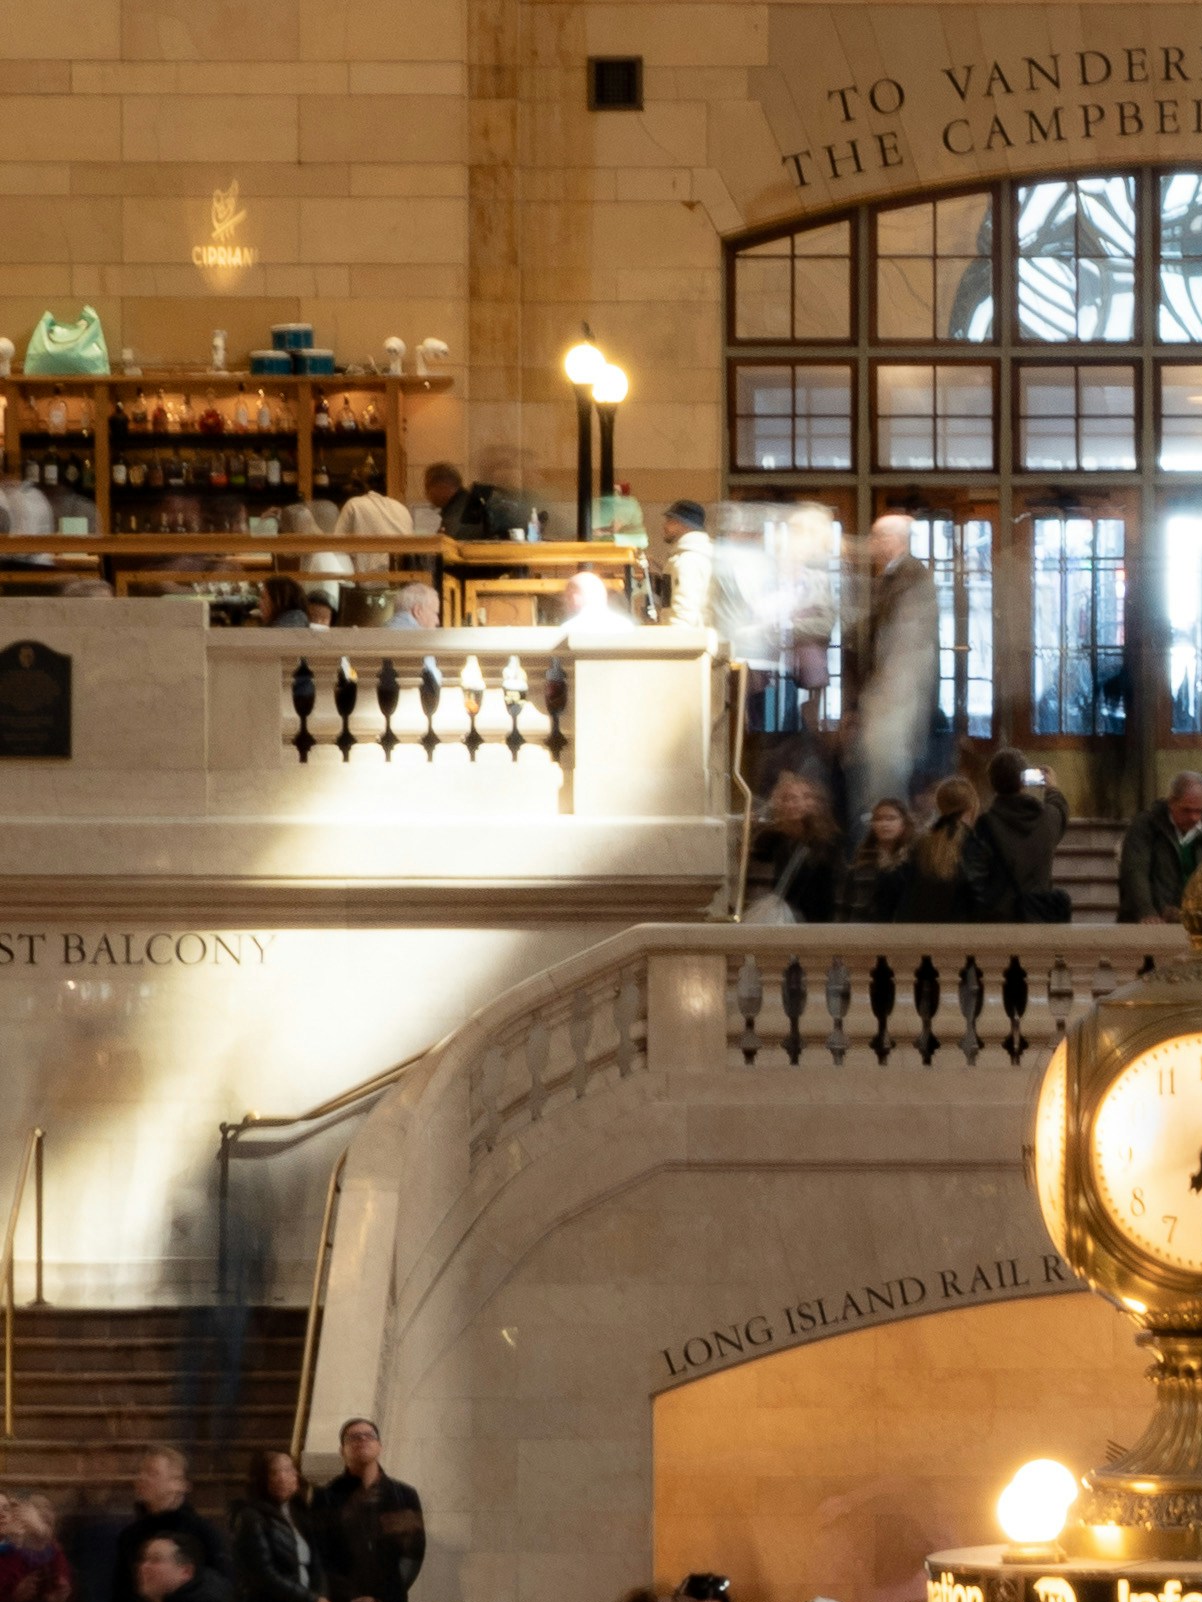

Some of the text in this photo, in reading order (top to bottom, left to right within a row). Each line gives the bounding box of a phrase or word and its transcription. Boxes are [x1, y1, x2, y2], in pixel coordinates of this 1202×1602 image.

[828, 78, 906, 124] TO
[781, 130, 905, 189] THE
[62, 932, 277, 966] BALCONY
[1158, 1065, 1176, 1096] 11
[1130, 1186, 1147, 1217] 8
[1161, 1215, 1178, 1244] 7
[662, 1315, 774, 1376] LONG
[785, 1276, 926, 1336] ISLAND
[938, 1258, 1030, 1299] RAIL
